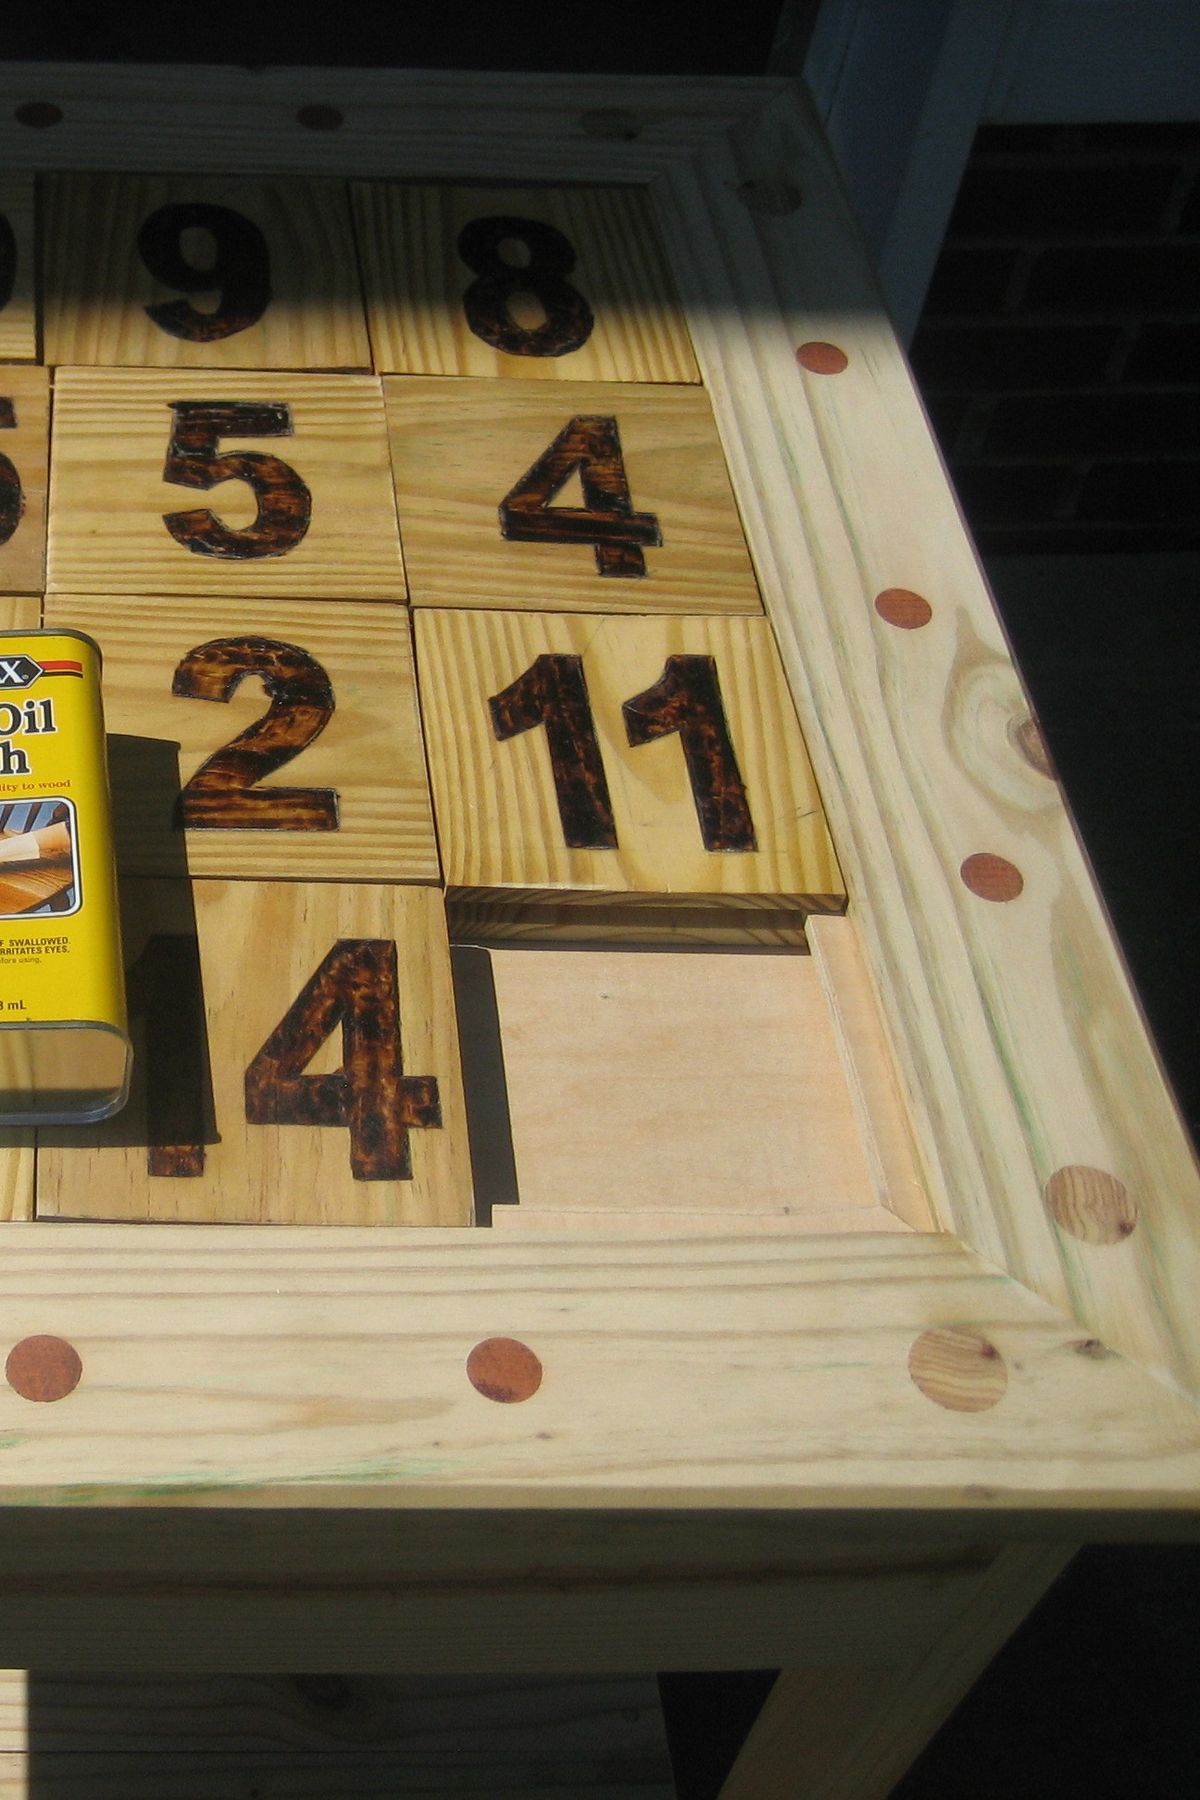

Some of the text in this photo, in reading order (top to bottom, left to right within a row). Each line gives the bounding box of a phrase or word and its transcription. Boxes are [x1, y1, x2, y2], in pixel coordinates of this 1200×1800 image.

[136, 201, 271, 342] 9
[457, 216, 594, 358] 8
[162, 401, 312, 560] 5
[500, 415, 662, 578] 4
[22, 783, 35, 791] to
[38, 780, 71, 789] wood
[172, 635, 340, 831] 2
[489, 654, 758, 852] 11
[8, 1000, 27, 1011] mL
[128, 934, 443, 1181] 14
